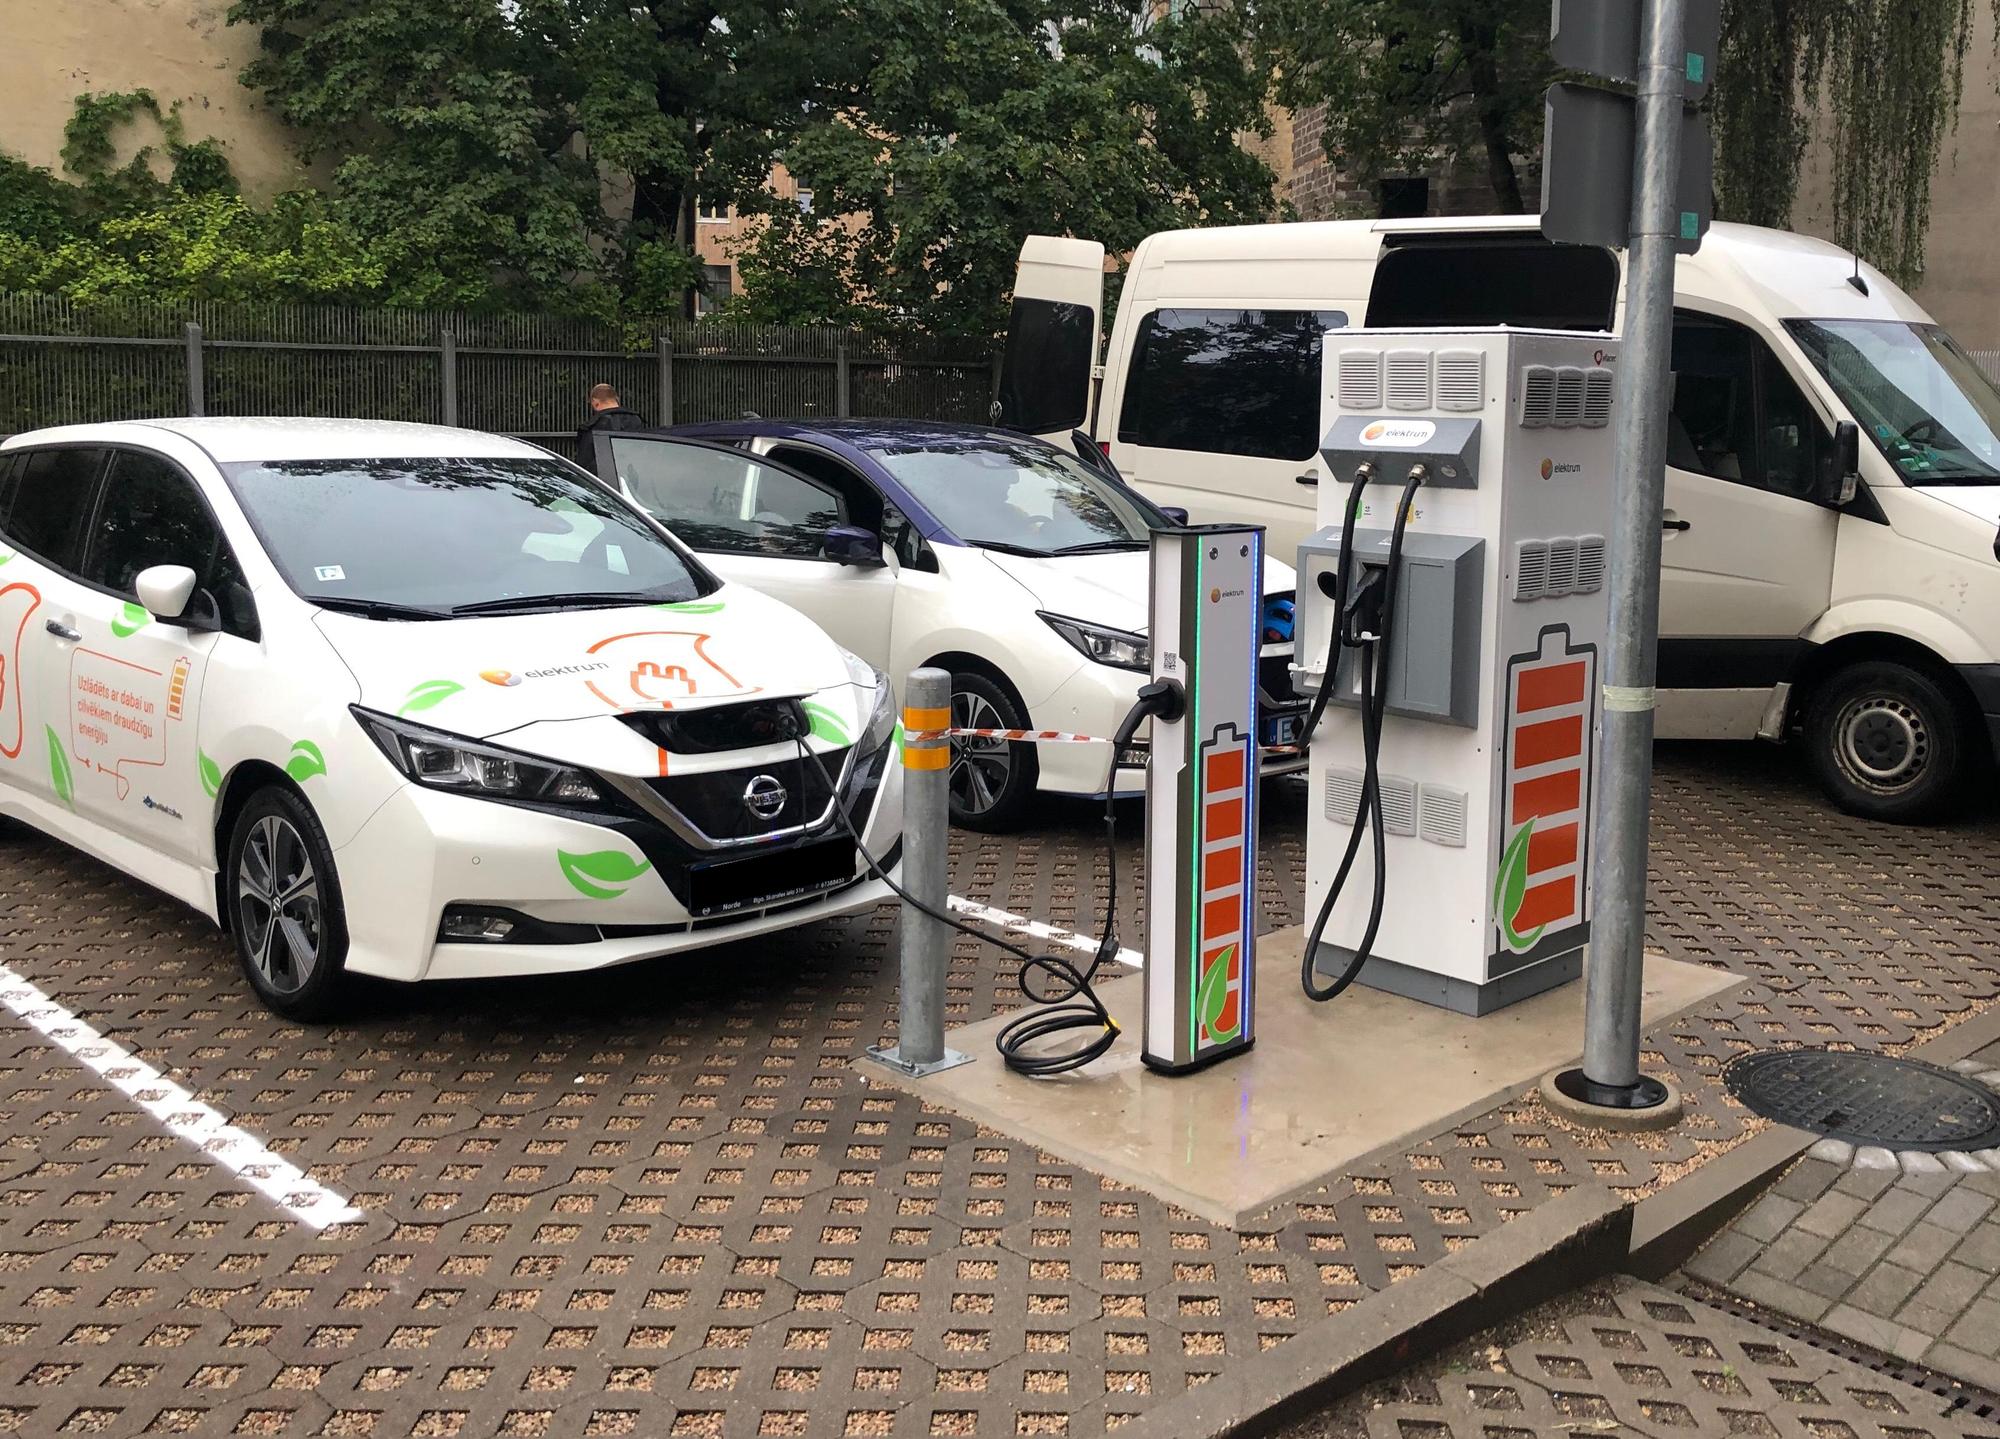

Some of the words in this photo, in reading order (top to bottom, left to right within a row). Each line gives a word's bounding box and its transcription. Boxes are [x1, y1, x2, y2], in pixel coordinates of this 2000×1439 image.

[1386, 428, 1428, 438] elektrum
[1554, 462, 1581, 473] elektrum
[1222, 590, 1244, 598] elektrum
[524, 662, 609, 678] elektrum
[111, 689, 119, 702] ar
[120, 689, 143, 710] dabai
[144, 701, 154, 714] un
[743, 789, 787, 807] NISSAN
[722, 901, 742, 911] Norde
